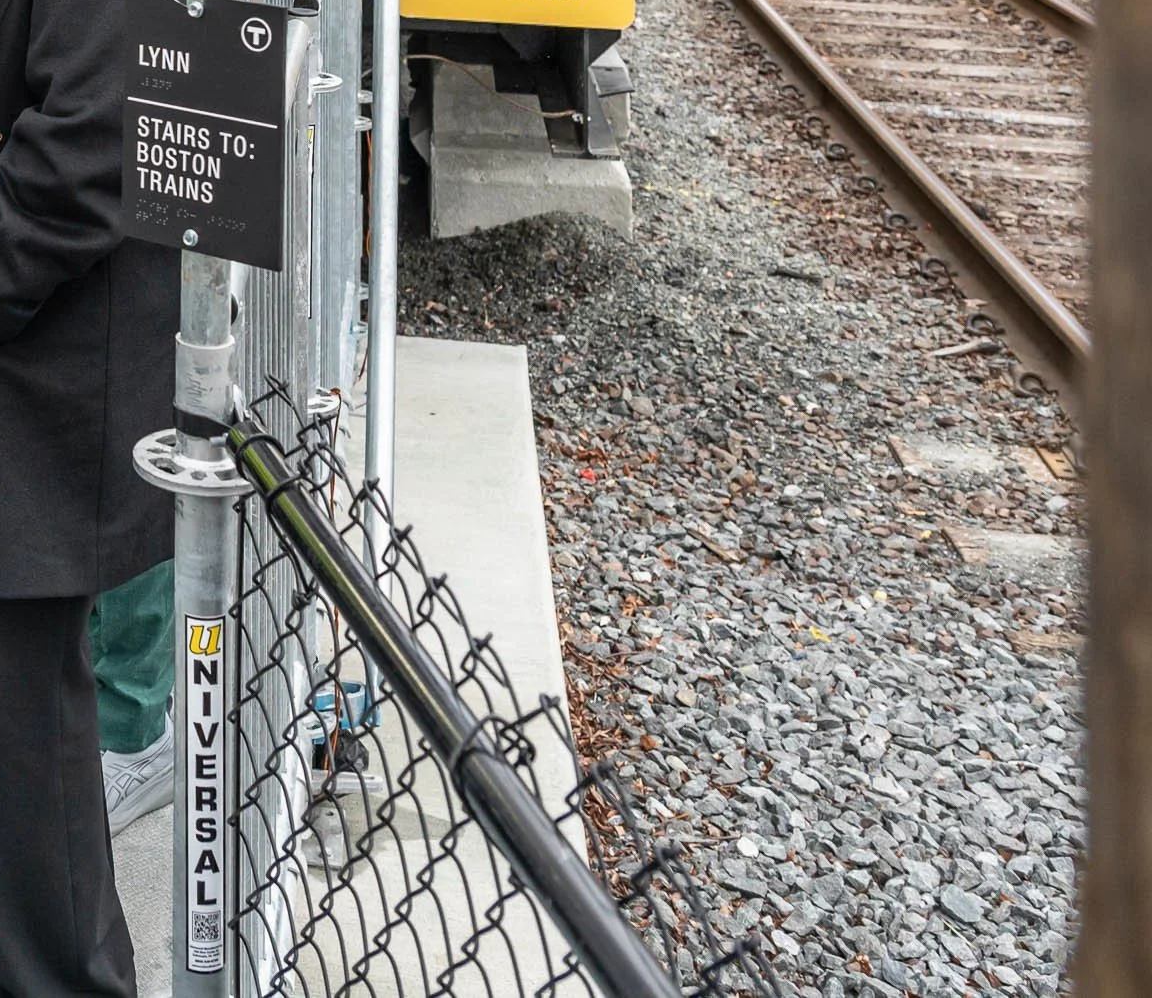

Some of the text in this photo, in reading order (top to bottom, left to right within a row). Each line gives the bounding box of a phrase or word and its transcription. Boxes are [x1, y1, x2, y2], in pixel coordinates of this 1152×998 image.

[138, 44, 190, 74] LYNN
[137, 115, 255, 160] STAIRS TO:
[136, 141, 221, 180] BOSTON
[136, 167, 214, 204] TRAINS
